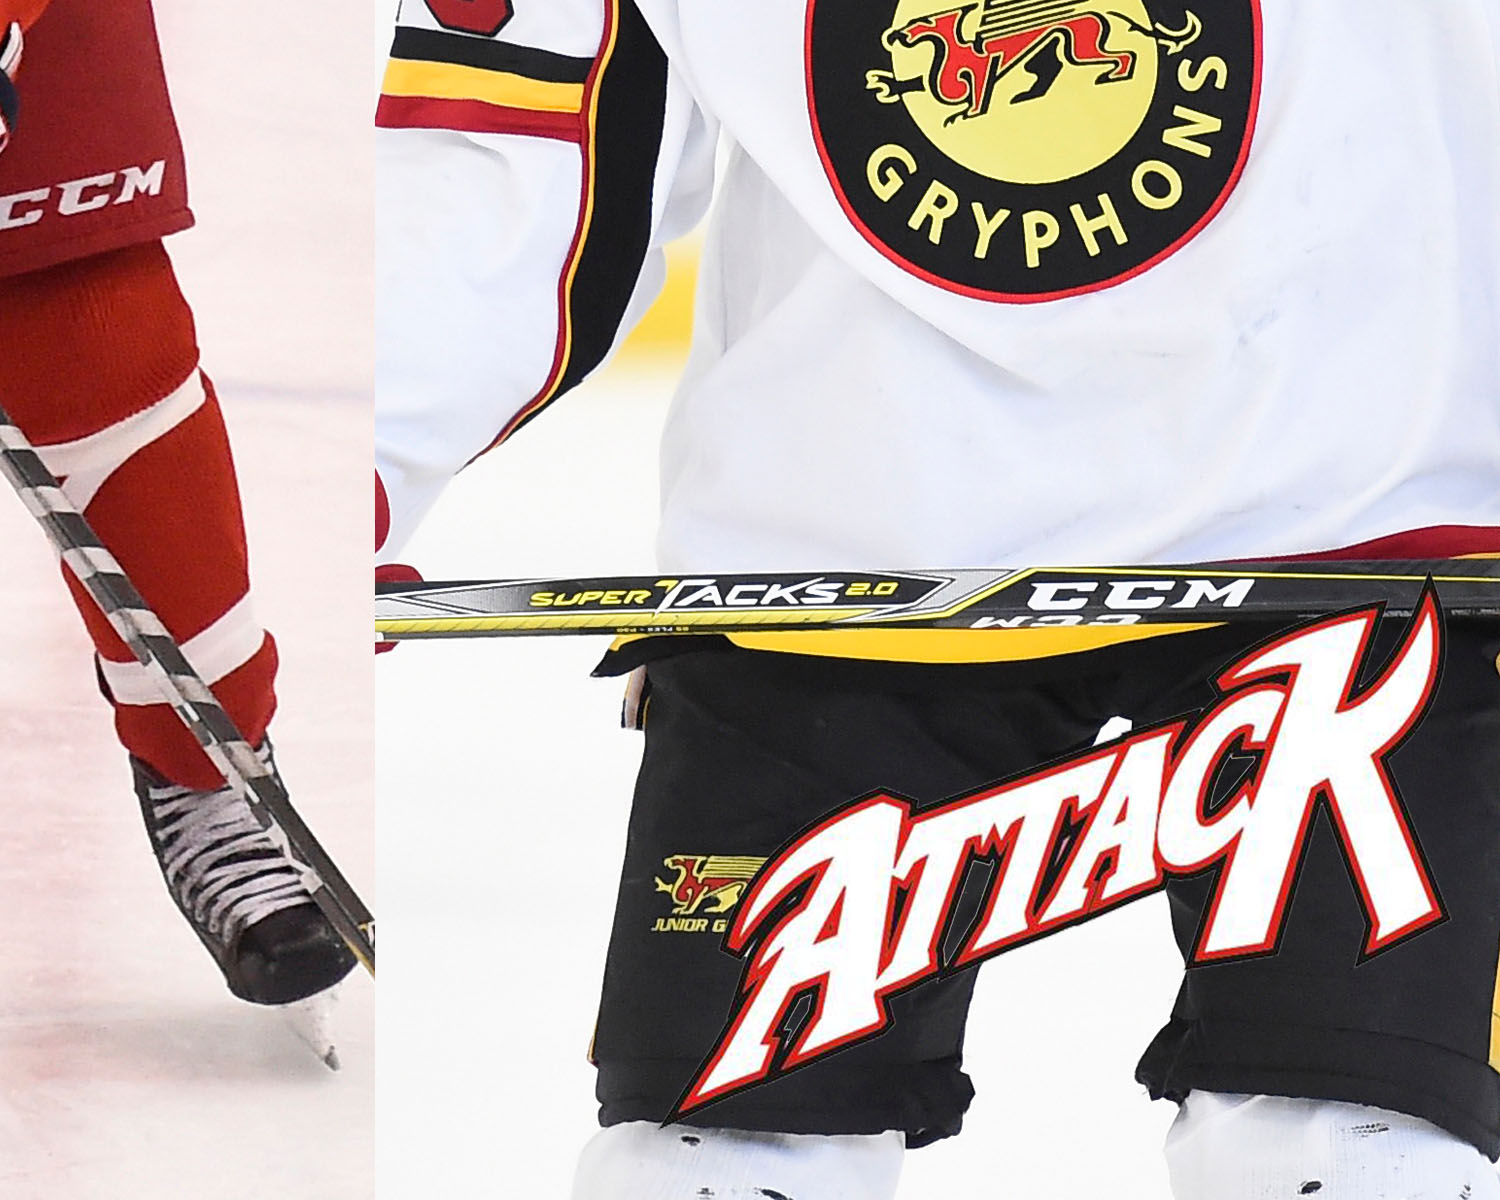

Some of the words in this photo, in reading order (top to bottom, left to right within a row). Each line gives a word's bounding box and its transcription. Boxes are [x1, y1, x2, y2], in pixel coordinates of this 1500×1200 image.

[865, 55, 1228, 269] GRYPHONS
[528, 589, 652, 608] SUPER
[653, 577, 846, 617] TACKS
[844, 581, 900, 597] 2.0
[1026, 578, 1256, 612] CCM
[650, 917, 709, 933] JUNIOR
